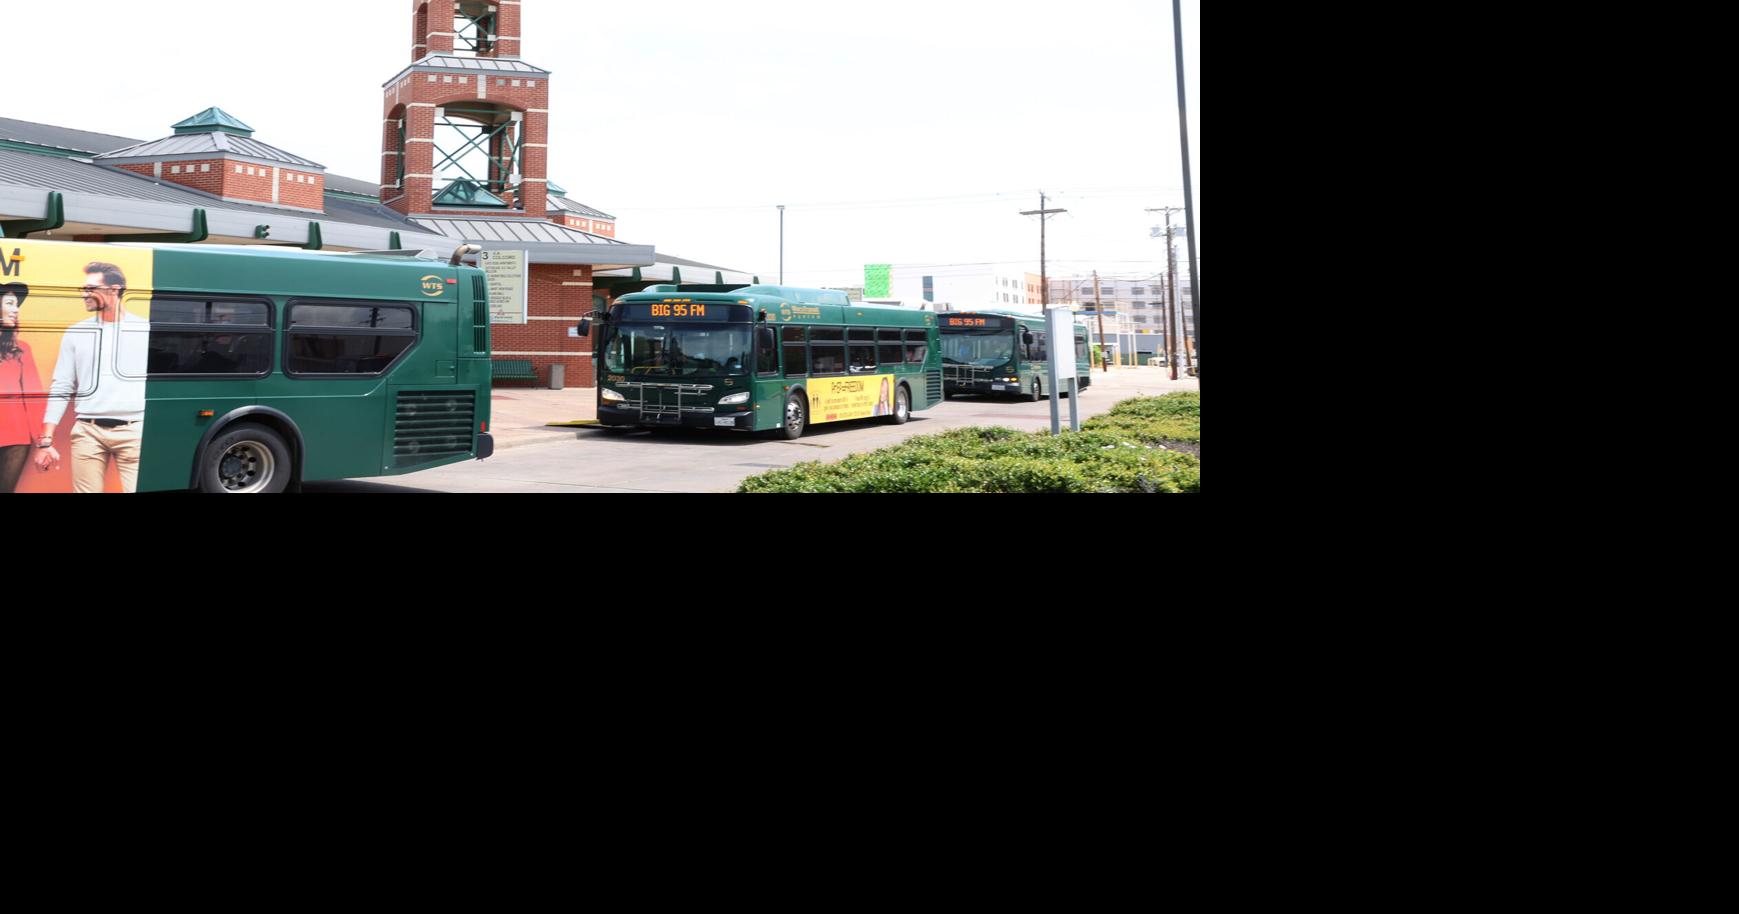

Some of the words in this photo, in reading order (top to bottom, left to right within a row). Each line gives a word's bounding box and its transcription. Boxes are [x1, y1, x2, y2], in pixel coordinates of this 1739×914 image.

[482, 251, 489, 260] 3
[422, 282, 443, 290] WTS
[651, 303, 671, 317] BIG
[673, 303, 688, 317] 95
[690, 303, 705, 317] FM
[963, 317, 974, 327] 95
